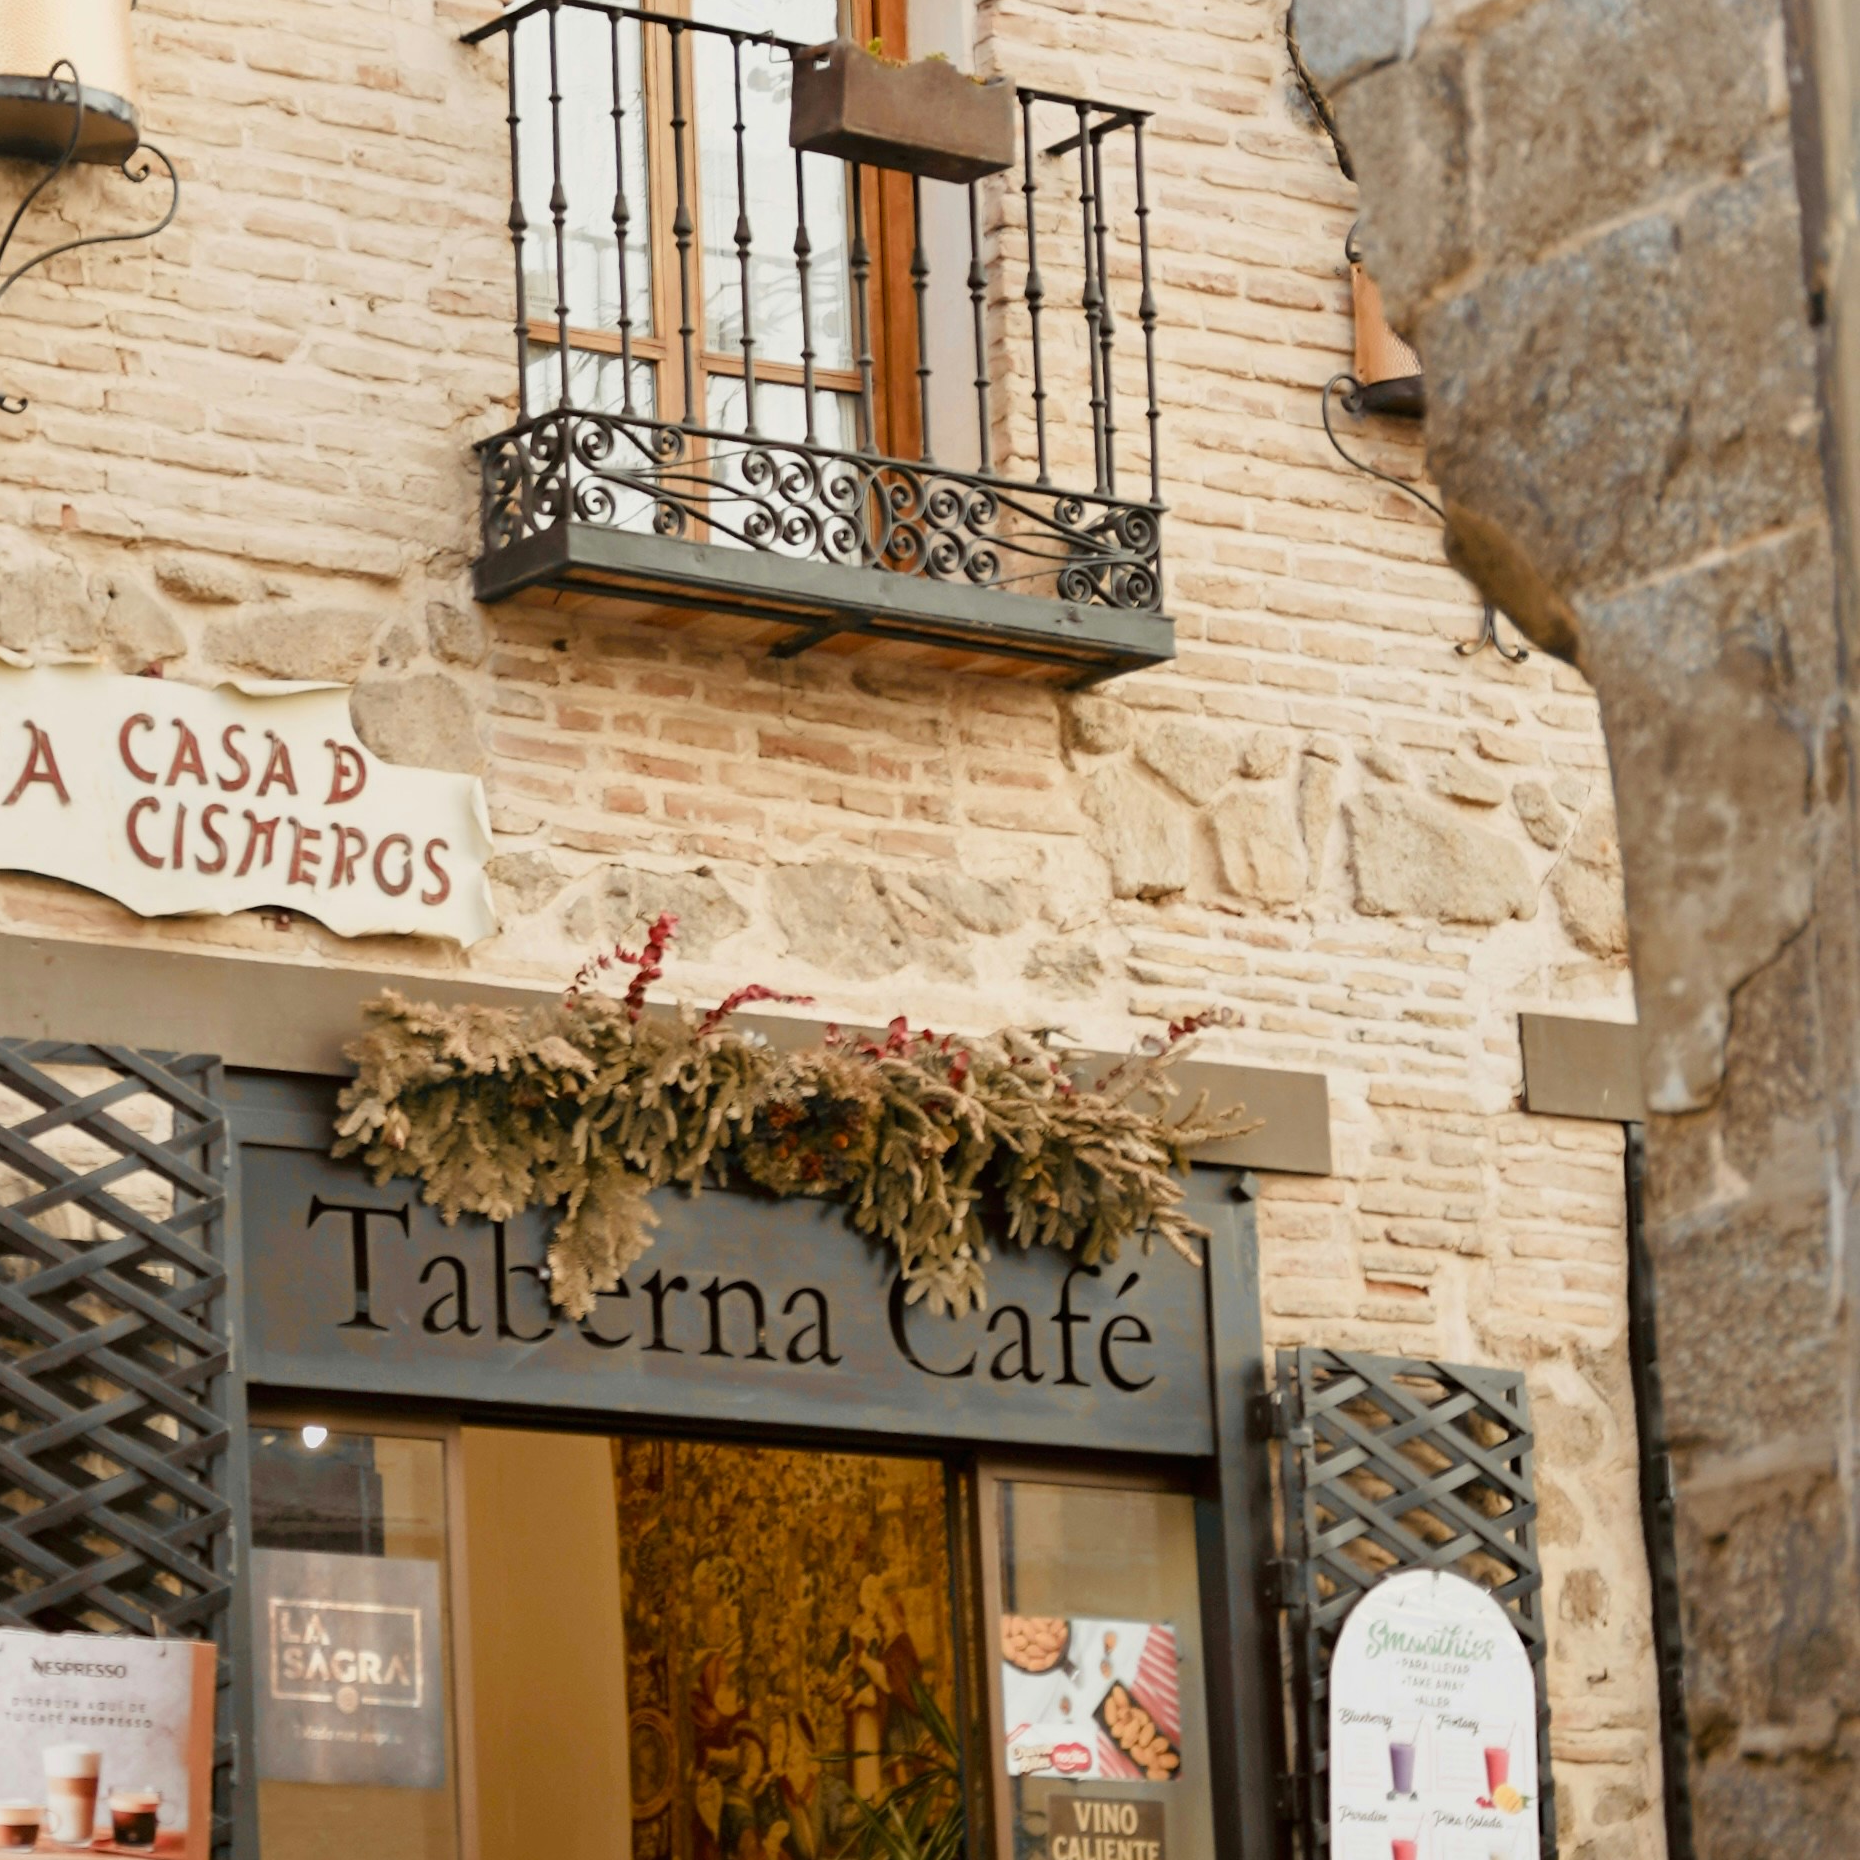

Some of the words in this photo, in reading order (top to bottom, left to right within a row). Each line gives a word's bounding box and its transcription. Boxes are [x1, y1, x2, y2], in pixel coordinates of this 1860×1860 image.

[119, 712, 299, 798] CASA
[125, 796, 452, 906] CISNEROS
[280, 1610, 331, 1646] LA
[1366, 1619, 1495, 1661] Smoothies
[30, 1657, 127, 1680] NESPRESSO
[282, 1646, 412, 1687] SAGRA
[1073, 1801, 1139, 1836] VINO
